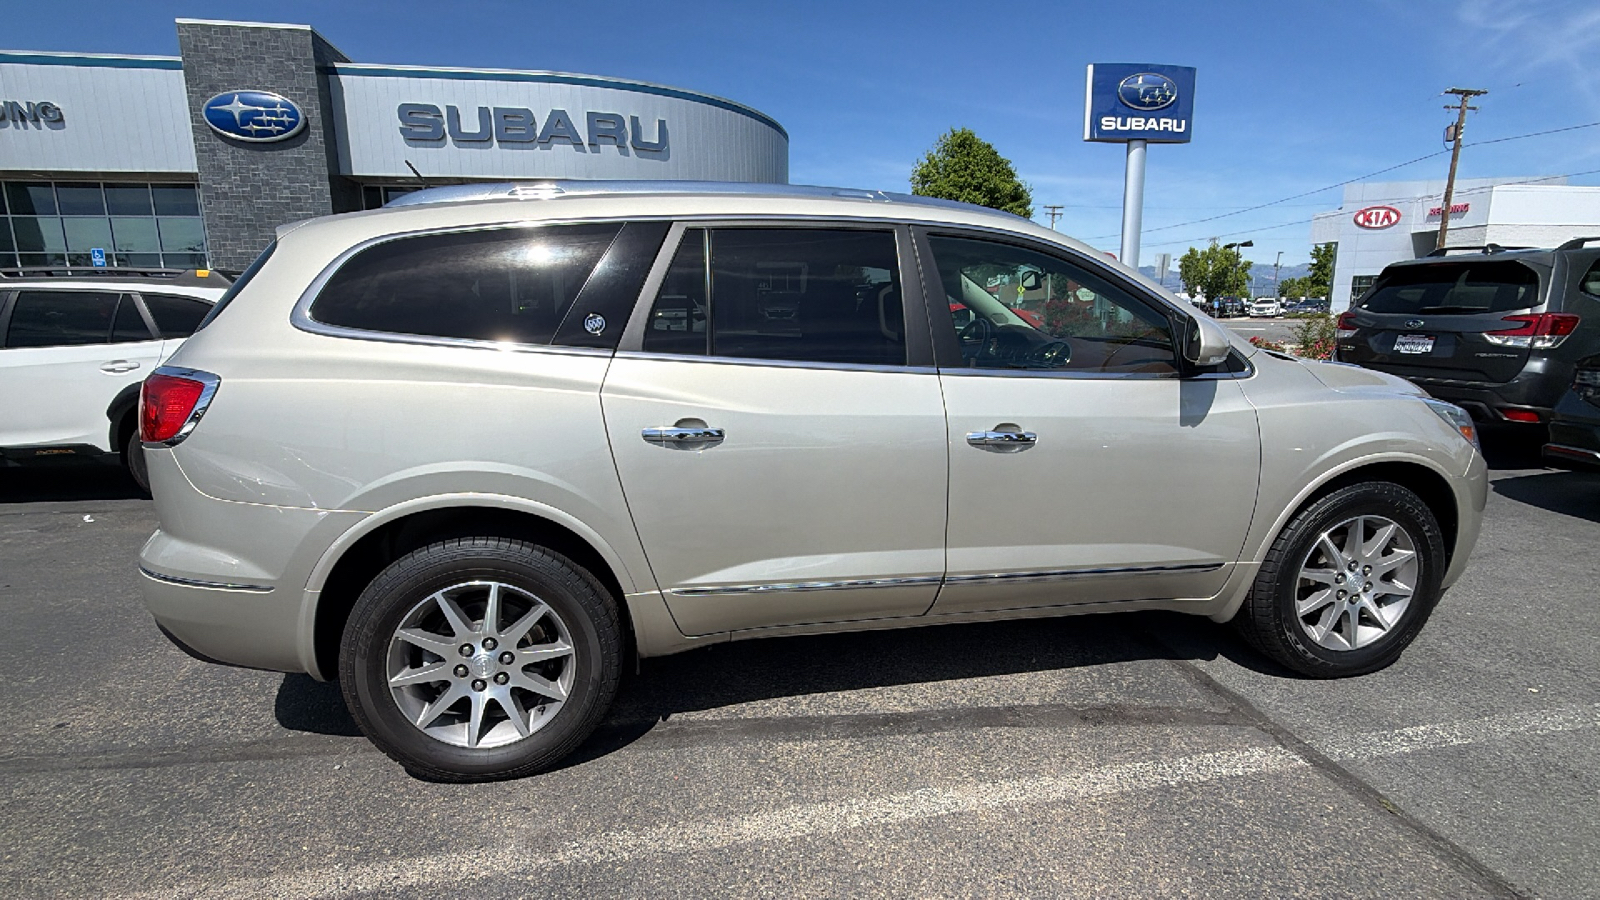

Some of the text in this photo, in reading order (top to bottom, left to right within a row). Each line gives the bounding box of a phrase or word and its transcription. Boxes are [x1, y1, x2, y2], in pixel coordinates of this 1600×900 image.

[397, 103, 667, 152] SUBARU
[1101, 116, 1186, 133] SUBARU
[1428, 203, 1470, 216] REDING
[1361, 210, 1393, 226] KIA
